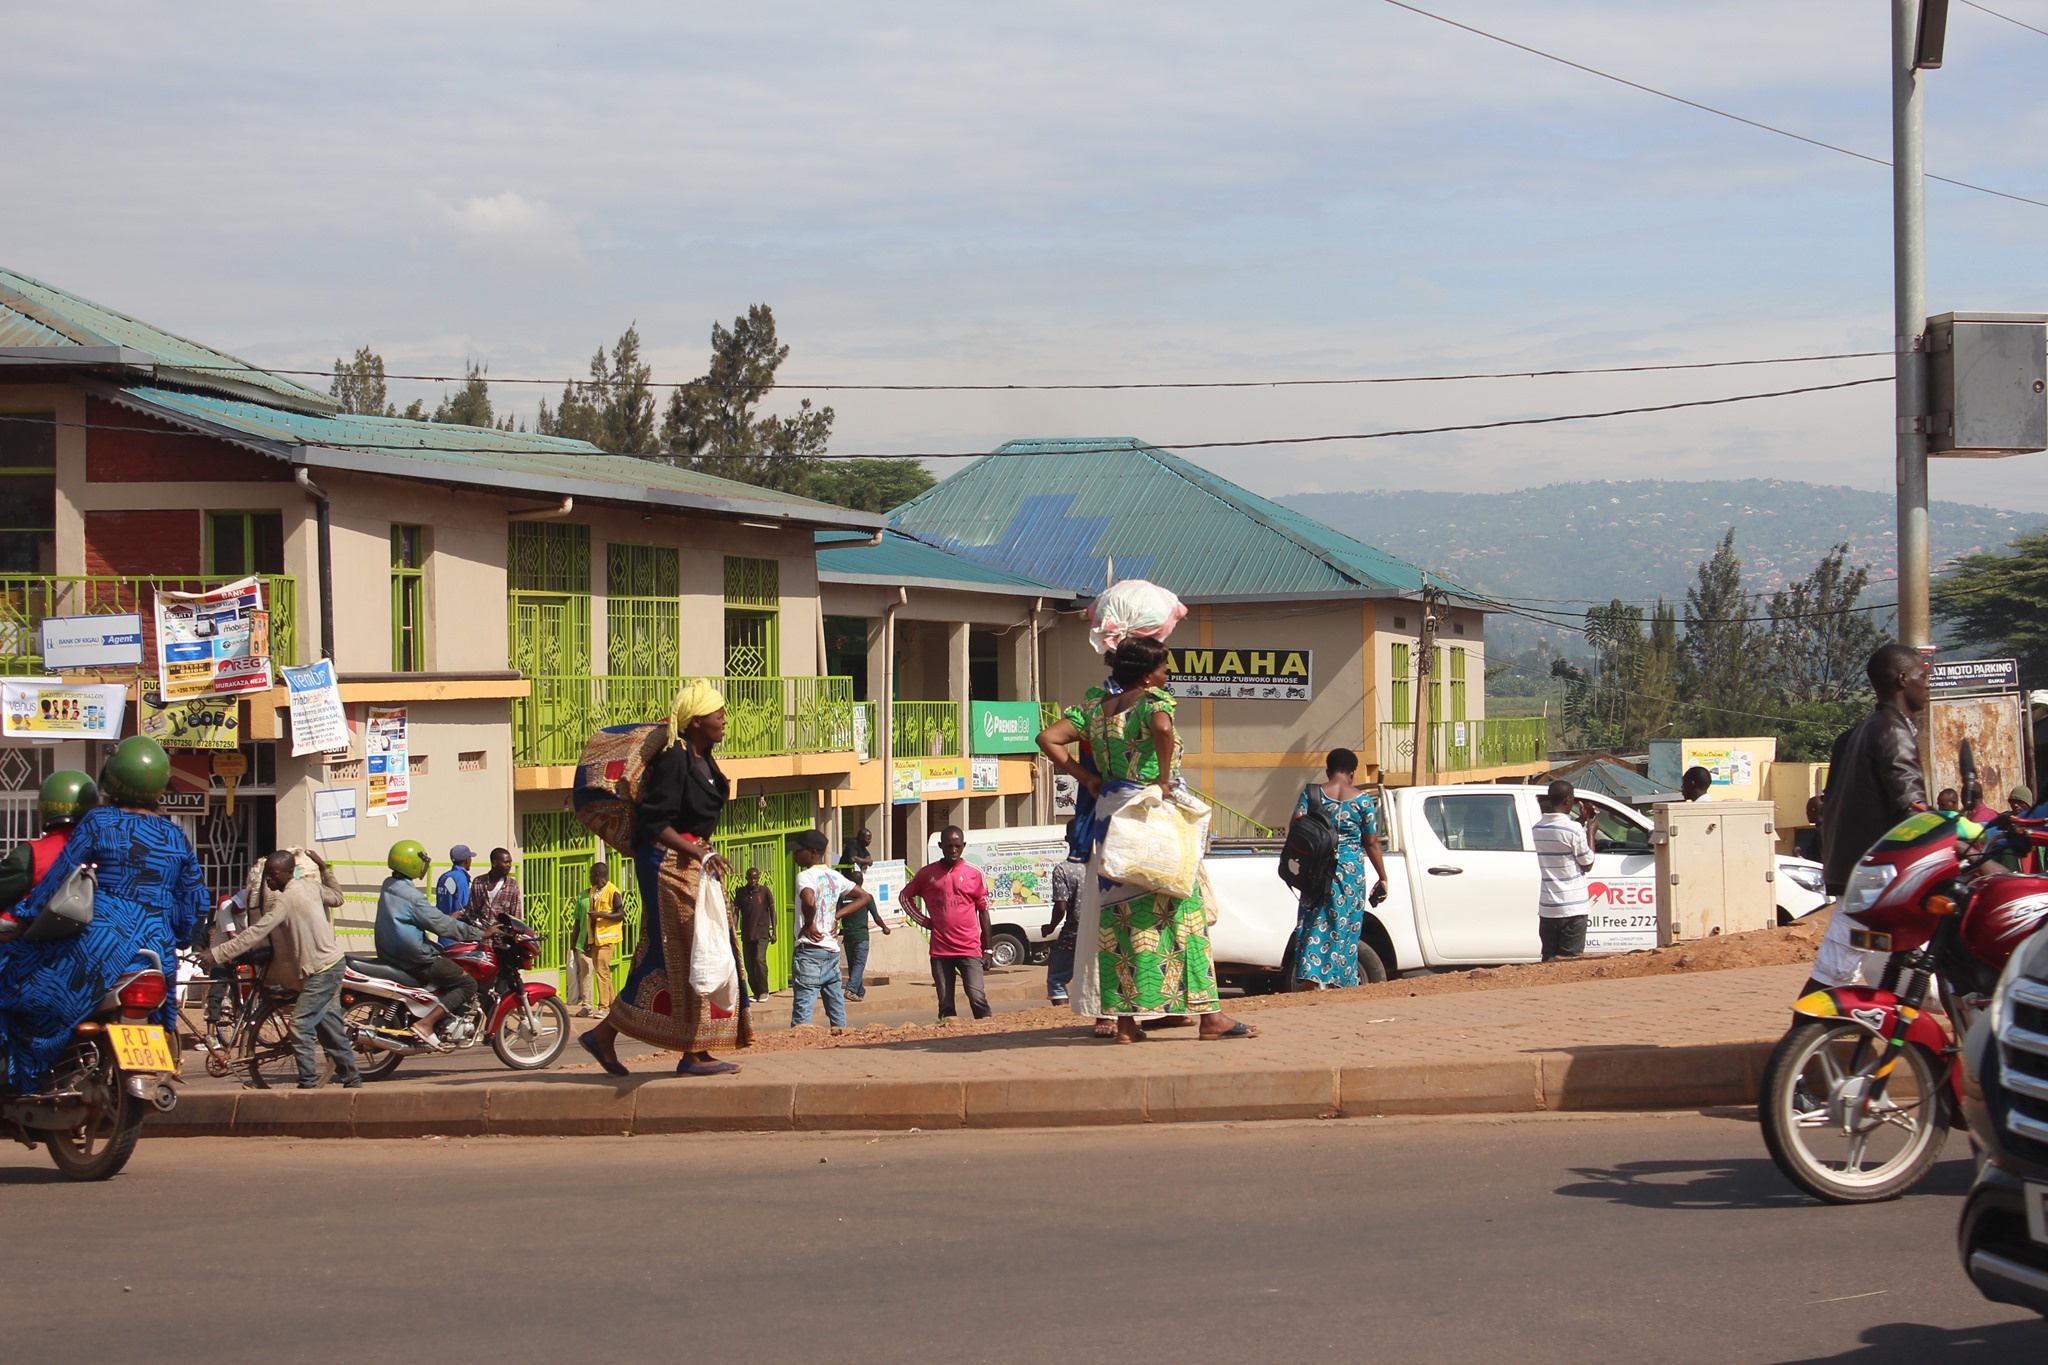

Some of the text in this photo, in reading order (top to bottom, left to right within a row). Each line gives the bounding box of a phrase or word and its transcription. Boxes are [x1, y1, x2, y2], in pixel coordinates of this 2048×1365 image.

[221, 588, 246, 599] BANK
[108, 635, 133, 644] Agent
[232, 658, 260, 670] REG
[1166, 650, 1308, 676] AMAHA
[1934, 663, 2012, 676] AXI MOTO PARKING
[215, 680, 249, 689] MURAKAZA
[157, 794, 201, 805] QUITY
[1609, 888, 1653, 904] REG
[1586, 916, 1657, 927] oll Free 2727
